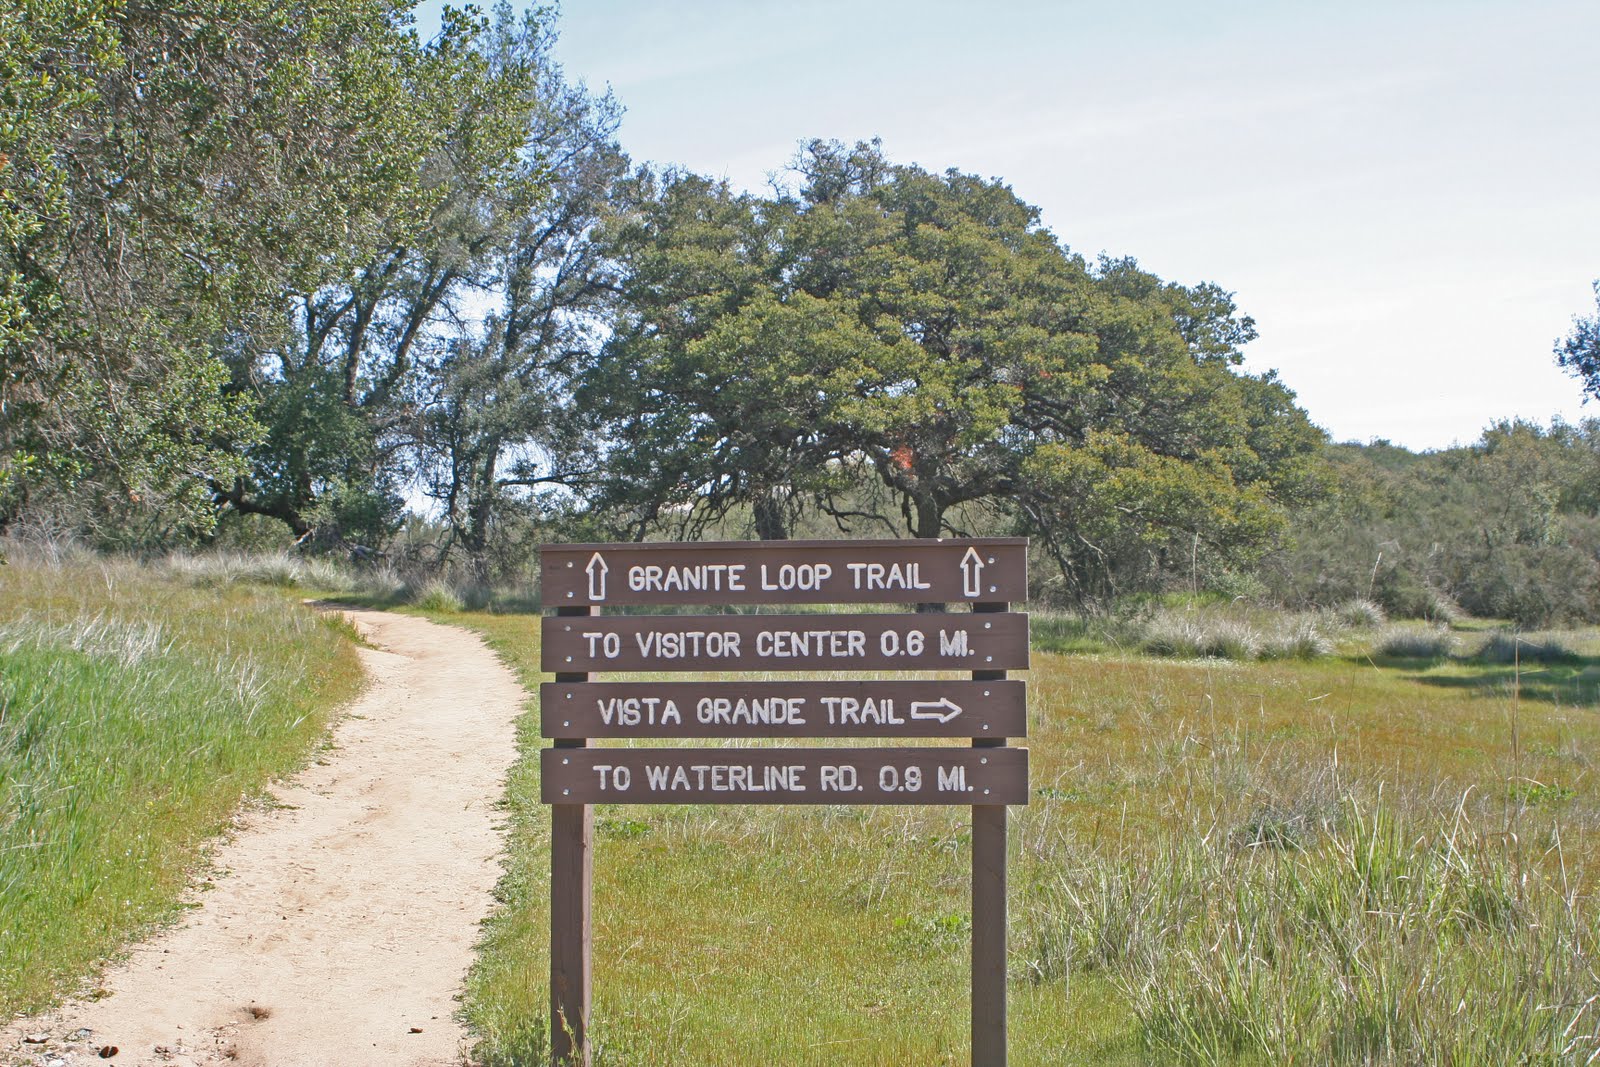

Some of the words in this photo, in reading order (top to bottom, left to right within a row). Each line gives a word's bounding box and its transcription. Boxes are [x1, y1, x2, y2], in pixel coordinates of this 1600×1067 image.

[628, 565, 746, 592] GRANITE
[760, 563, 832, 591] LOOP
[847, 563, 931, 590] TRAIL
[582, 632, 620, 659] TO
[635, 631, 741, 658] VISITOR
[756, 630, 867, 657] CENTER
[880, 629, 925, 657] 0.6
[939, 629, 975, 656] MI.
[597, 697, 682, 725] VISTA
[696, 697, 806, 725] GRANDE
[820, 696, 905, 725] TRAIL
[592, 765, 631, 791] TO
[645, 765, 806, 792] WATERLINE
[820, 765, 864, 792] RD.
[878, 765, 922, 792] 0.9
[937, 765, 974, 792] MI.
